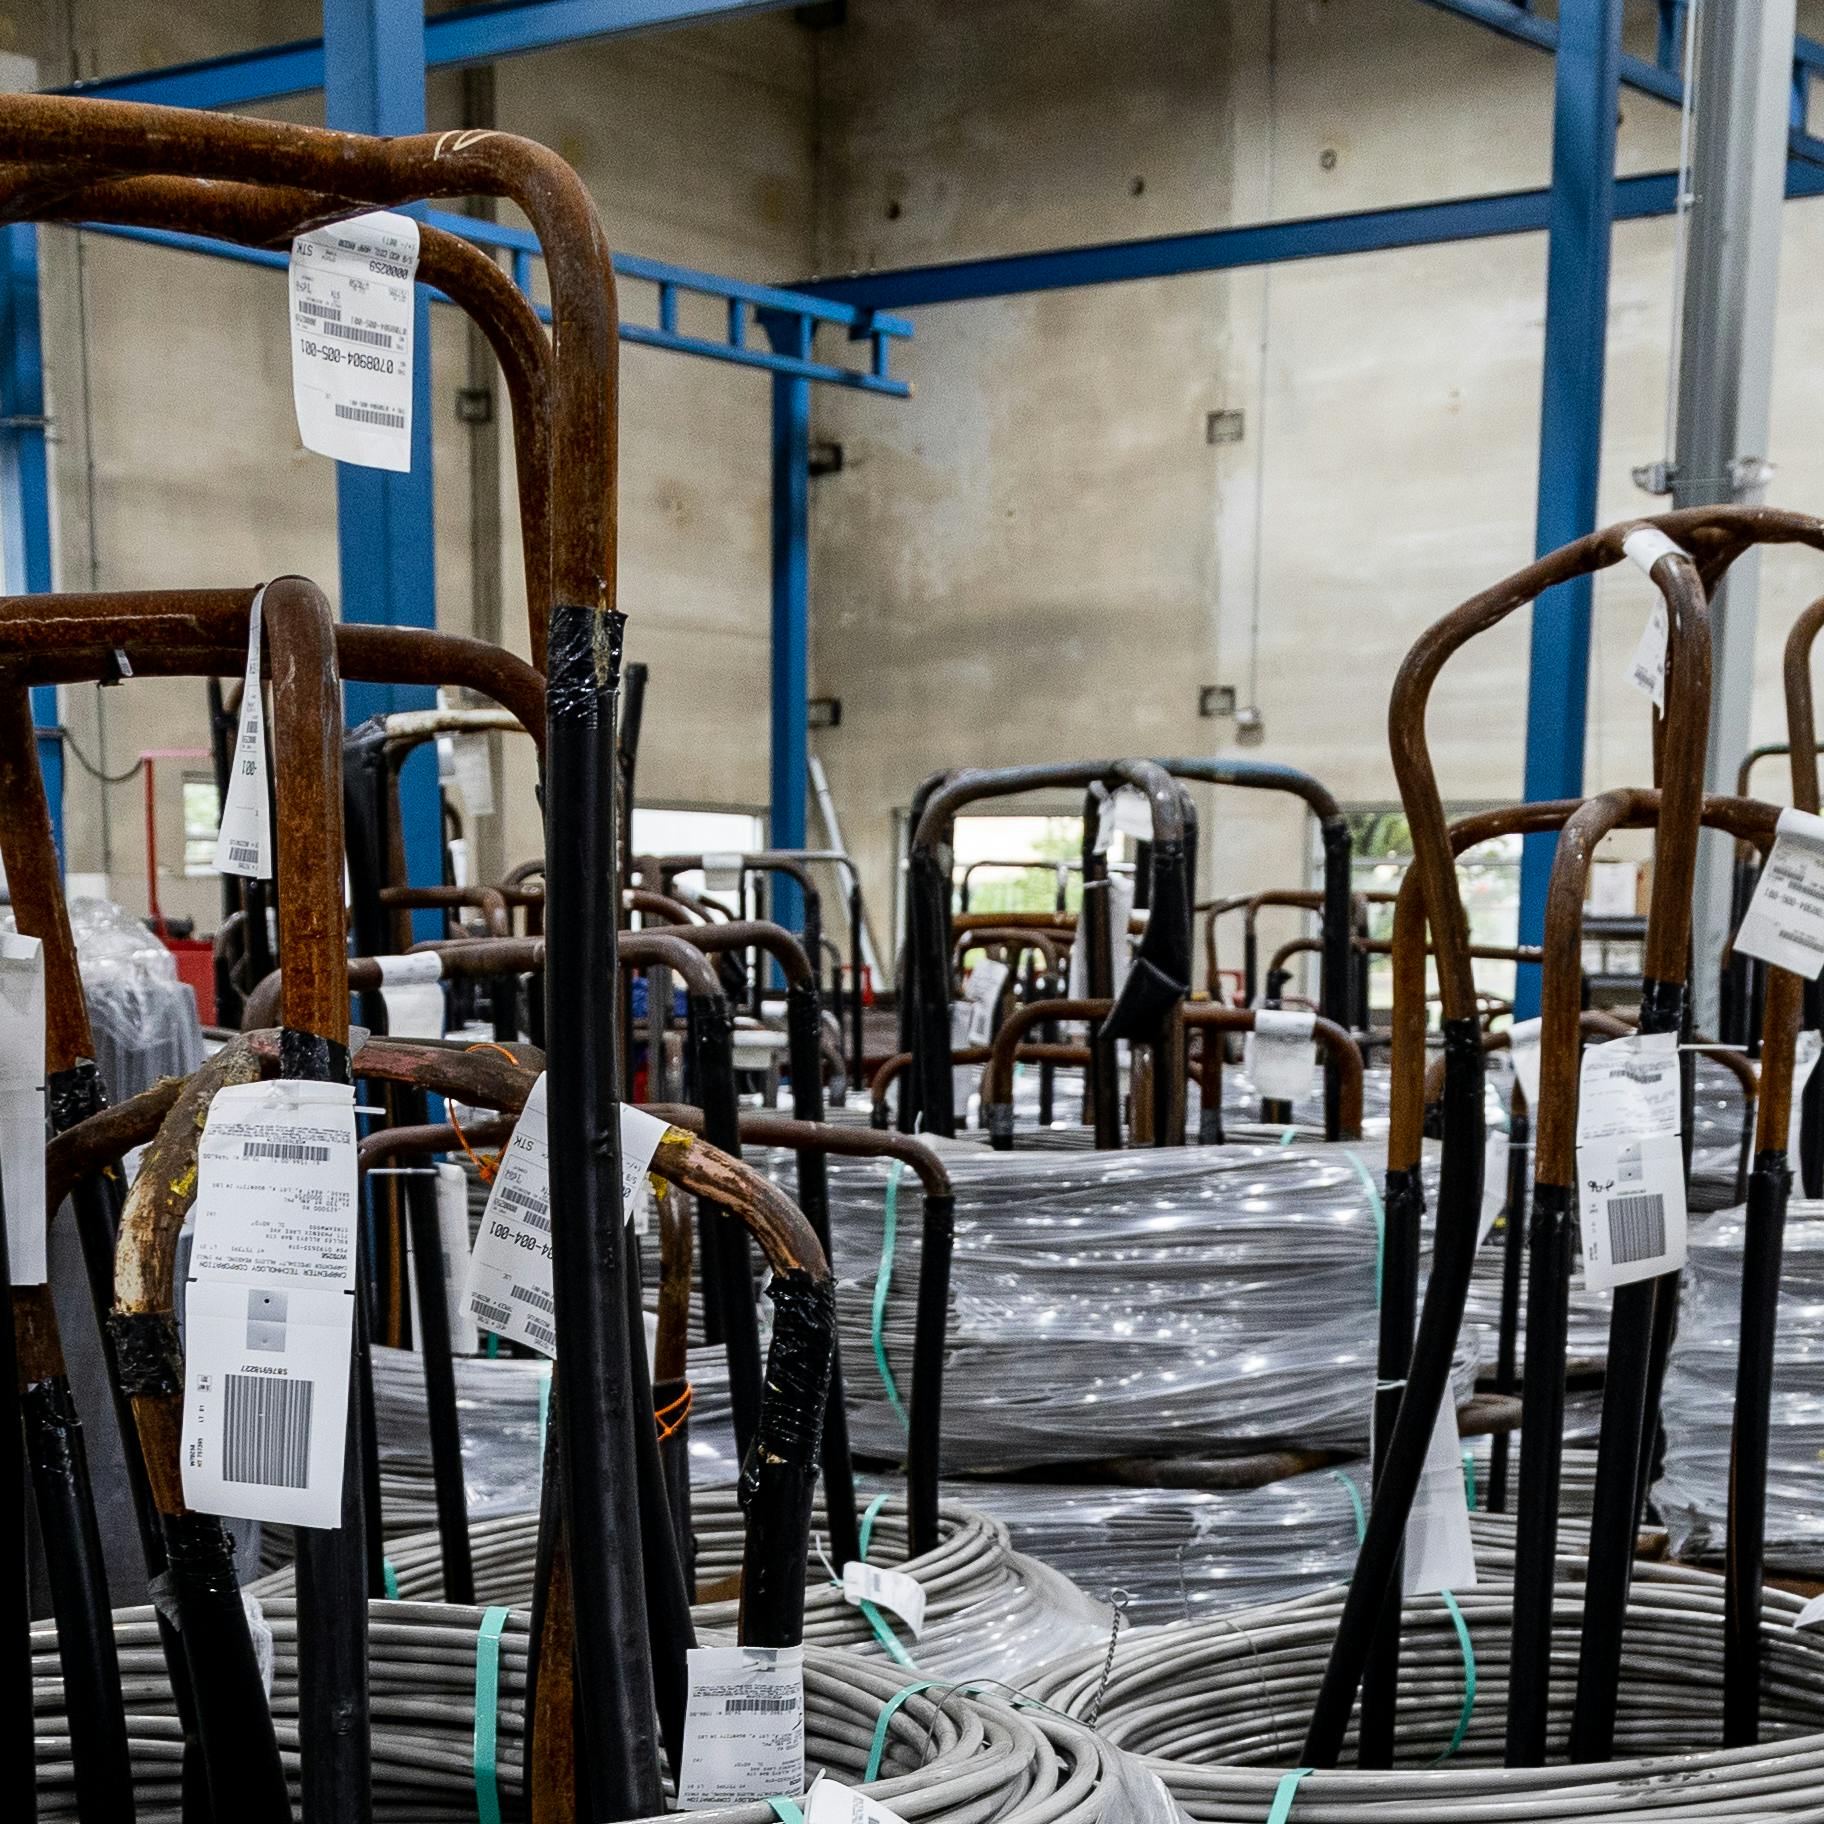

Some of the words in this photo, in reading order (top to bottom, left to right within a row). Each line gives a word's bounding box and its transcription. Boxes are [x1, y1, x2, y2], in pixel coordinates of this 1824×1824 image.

[295, 242, 313, 256] STK
[301, 339, 394, 374] 0708904-005-001
[513, 1135, 535, 1151] STK
[198, 1261, 247, 1271] CORPORATION
[251, 1264, 297, 1275] TECHNOLOGY
[303, 1268, 346, 1278] CARPENTER
